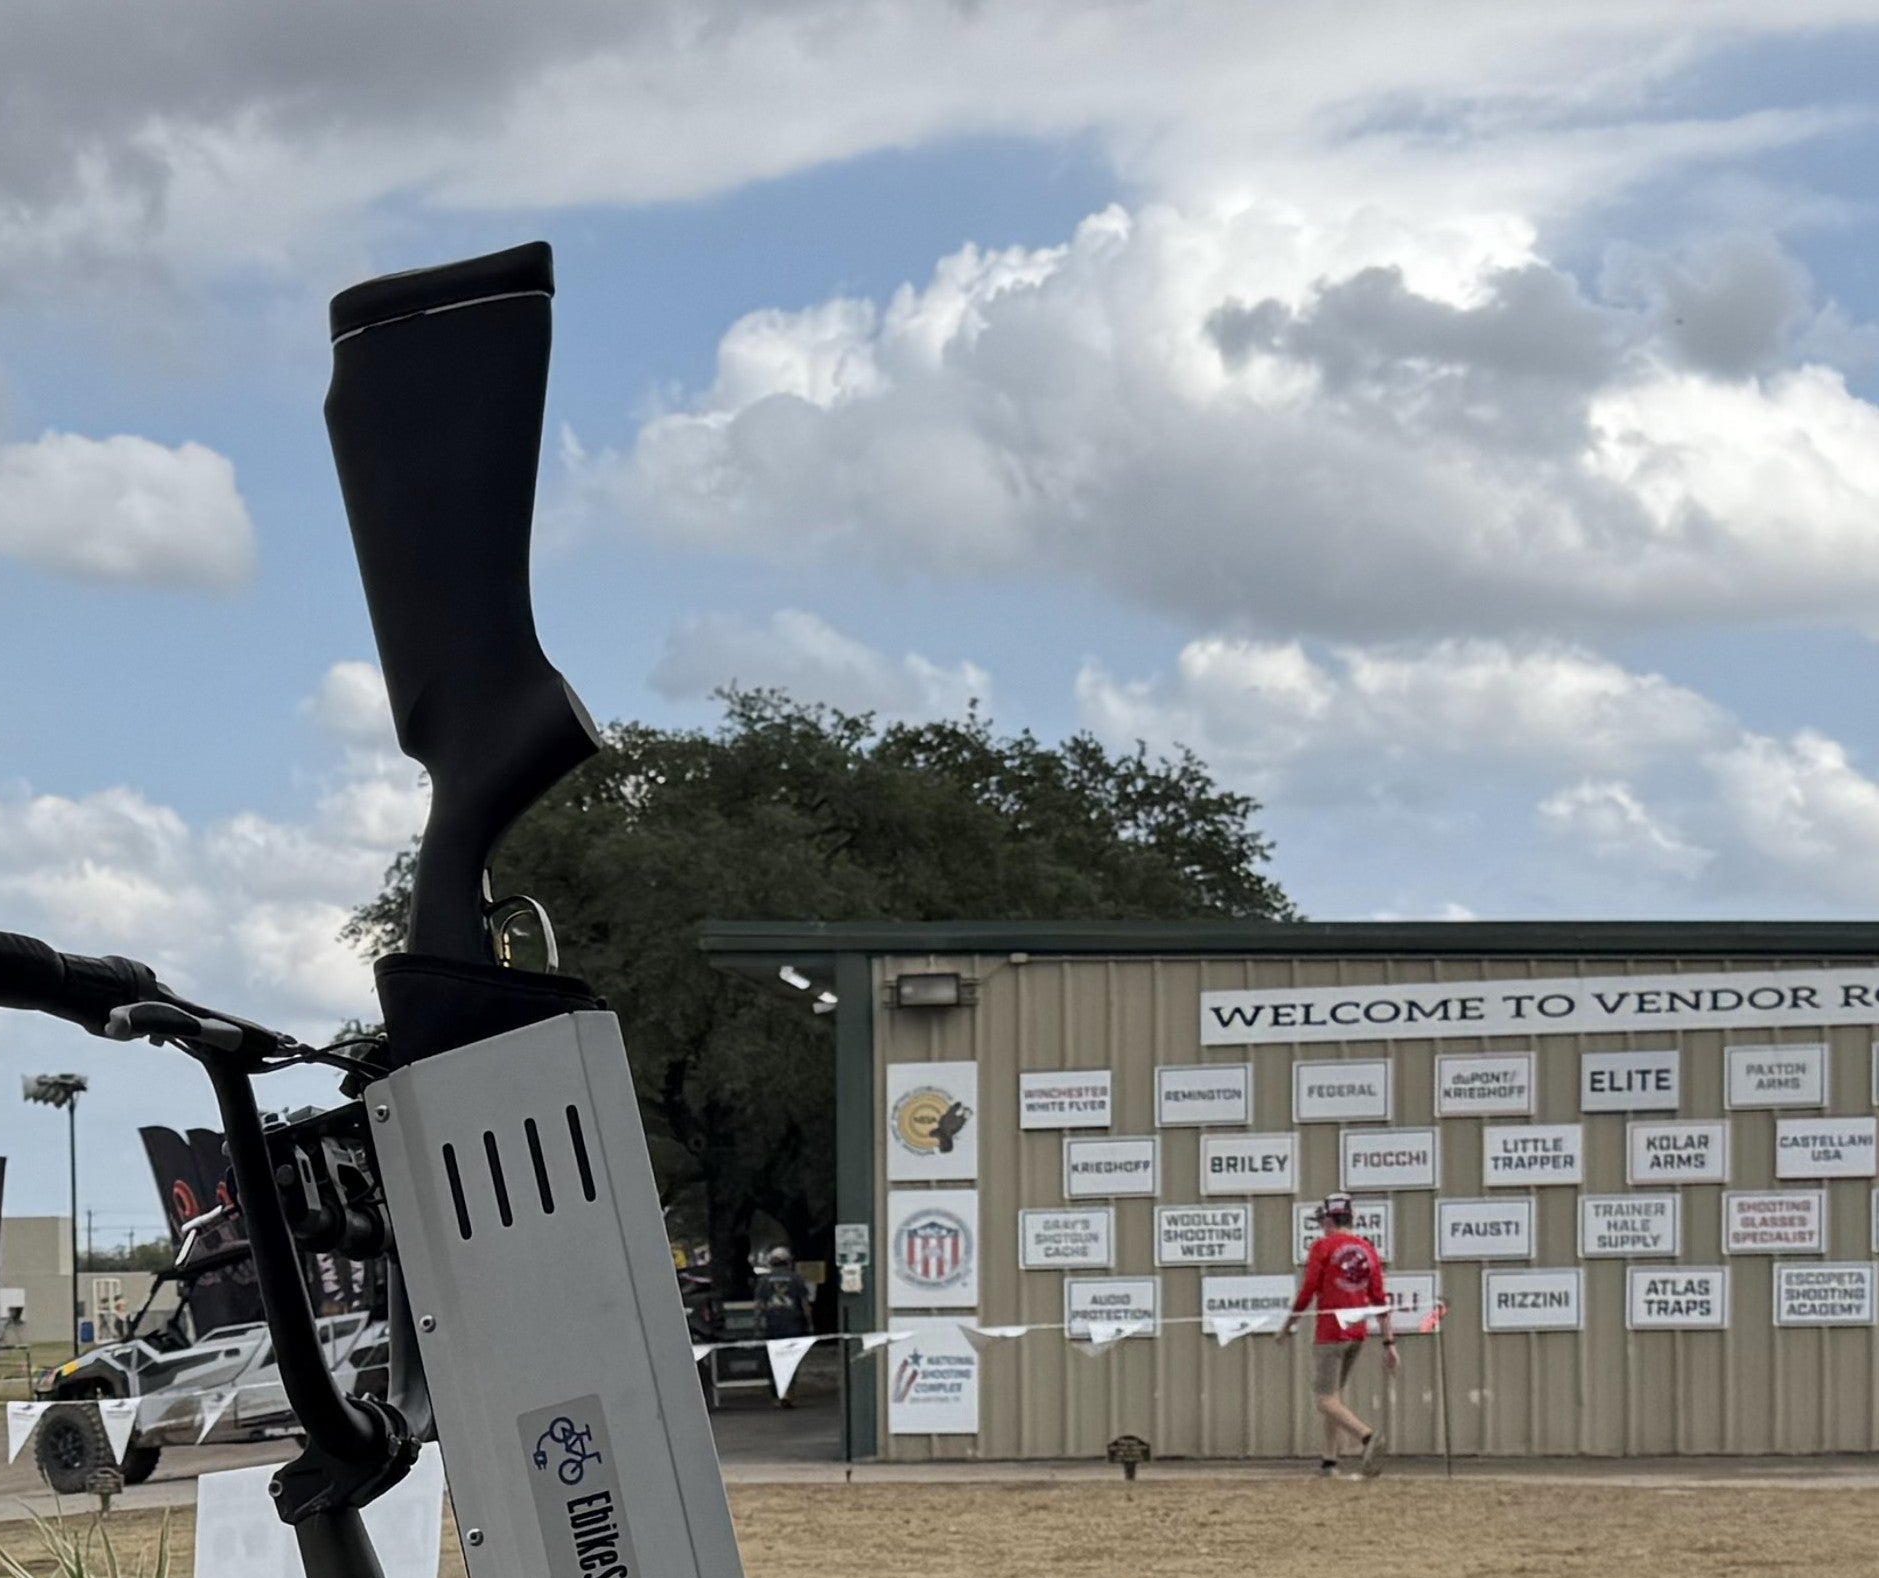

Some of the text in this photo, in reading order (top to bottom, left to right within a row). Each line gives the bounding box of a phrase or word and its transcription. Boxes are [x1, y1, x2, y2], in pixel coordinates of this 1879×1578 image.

[1209, 985, 1879, 1028] WELCOME TO VENDOR R
[1745, 1063, 1806, 1076] PAXTON
[1590, 1069, 1672, 1092] ELITE
[1755, 1077, 1801, 1090] ARMS
[1024, 1086, 1108, 1099] WINCHESTER
[1164, 1088, 1242, 1102] REMINGTON
[1307, 1084, 1377, 1098] FEDERAL
[1443, 1085, 1526, 1099] KRIEGHOFF
[1025, 1100, 1107, 1112] WHITE FLYER
[1502, 1137, 1563, 1154] LITTLE
[1646, 1134, 1709, 1151] KOLAR
[1780, 1135, 1873, 1148] CASTELLANI
[1352, 1150, 1427, 1168] FIOCCHI
[1491, 1154, 1575, 1170] TRAPPER
[1649, 1153, 1706, 1169] ARMS
[1811, 1150, 1842, 1162] USA
[1071, 1160, 1150, 1173] KRIEGHOFF
[1211, 1154, 1288, 1173] BRILEY
[1593, 1202, 1665, 1217] TRAINER
[1737, 1200, 1810, 1213] SHOOTING
[1165, 1212, 1241, 1226] WOOLLEY
[1607, 1219, 1651, 1232] HALE
[1740, 1216, 1807, 1228] GLASSES
[1163, 1228, 1243, 1242] SHOOTING
[1451, 1221, 1519, 1238] FAUSTI
[1597, 1234, 1661, 1248] SUPPLY
[1732, 1230, 1815, 1244] SPECIALIST
[1181, 1243, 1226, 1257] WEST
[1785, 1272, 1865, 1286] ESCOPETA
[1646, 1279, 1710, 1296] ATLAS
[1785, 1287, 1865, 1301] SHOOTING
[1090, 1294, 1131, 1306] AUDIO
[1207, 1297, 1290, 1311] GAMEBORE
[1497, 1291, 1569, 1309] RIZZINI
[1071, 1308, 1152, 1321] PROTECTION
[1644, 1300, 1711, 1316] TRAPS
[1786, 1303, 1864, 1316] ACADEMY
